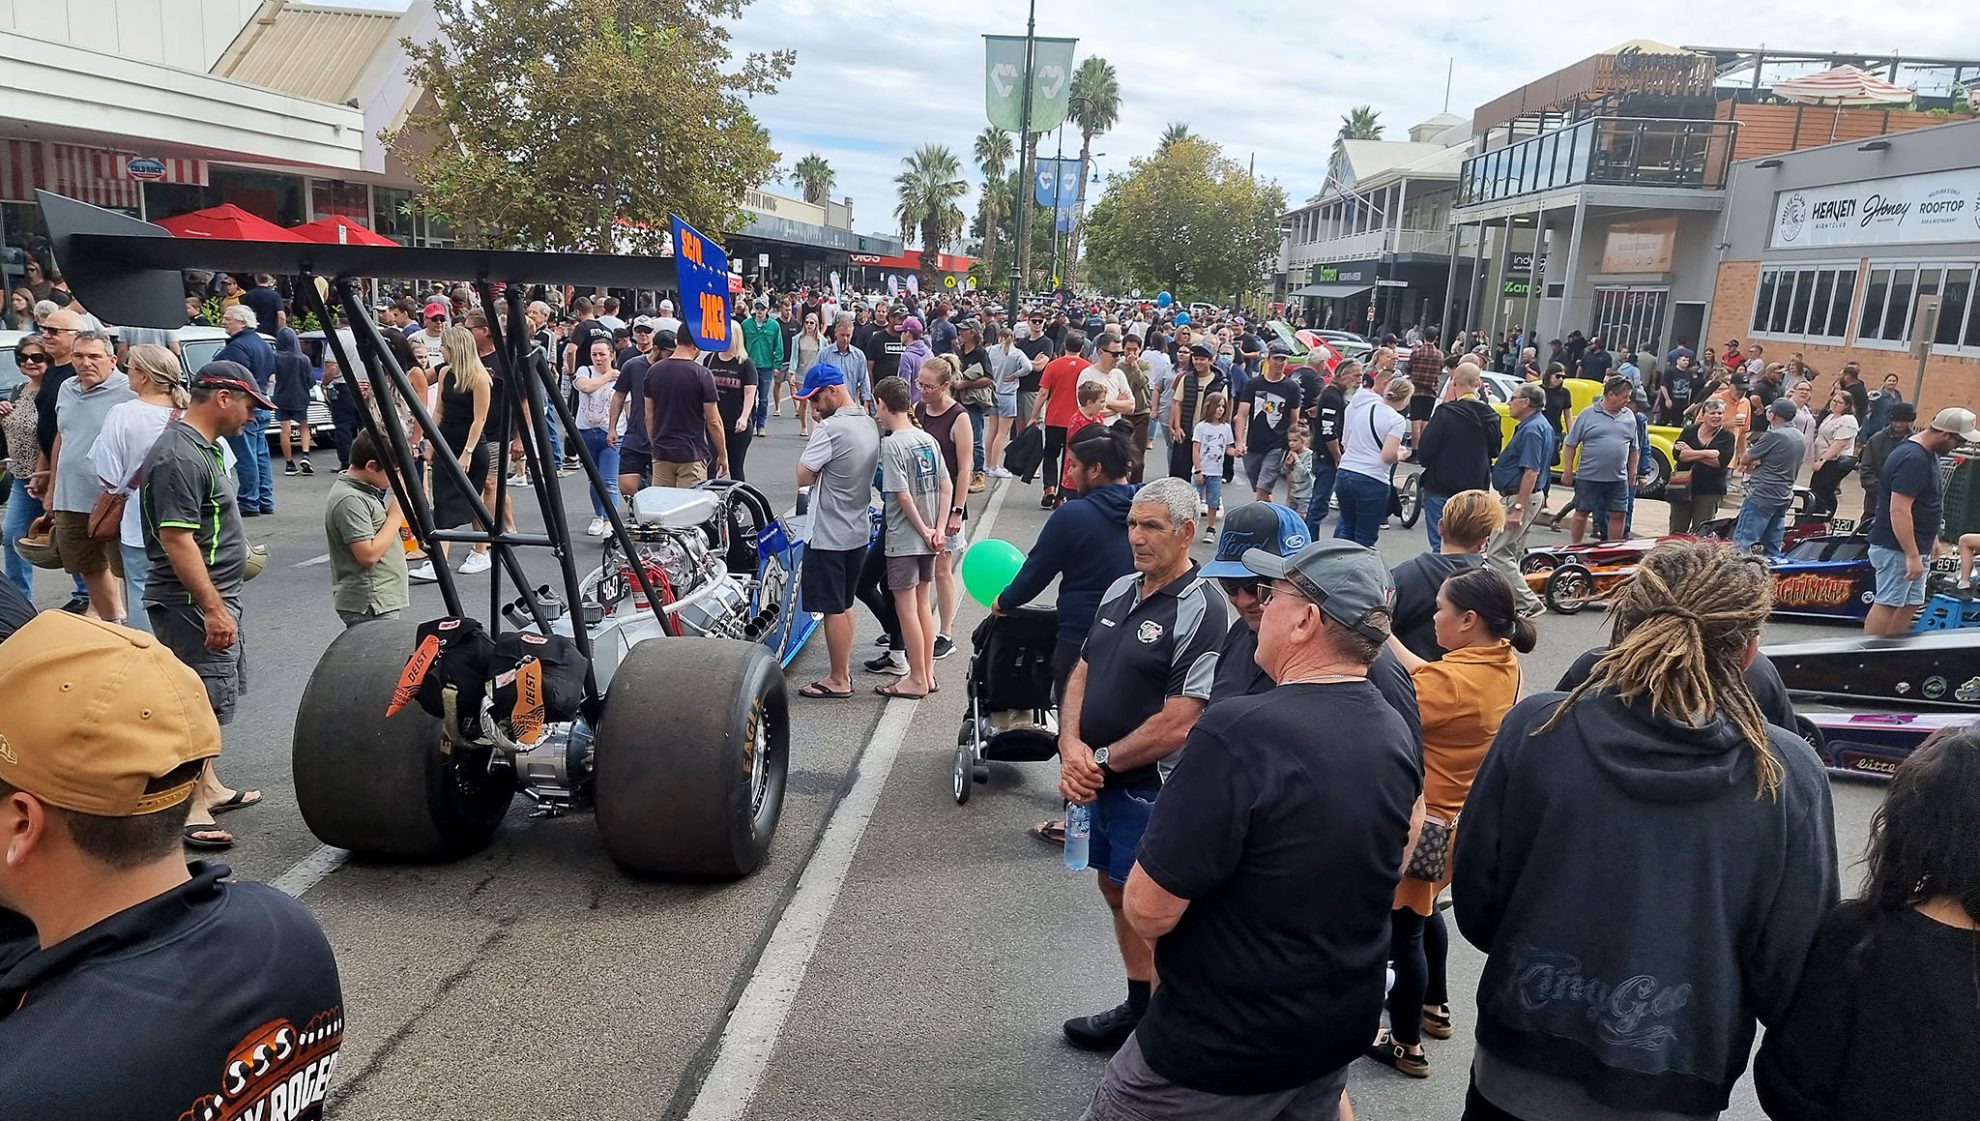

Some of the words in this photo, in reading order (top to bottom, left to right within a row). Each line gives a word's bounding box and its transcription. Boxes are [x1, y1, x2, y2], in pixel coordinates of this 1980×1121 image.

[1811, 199, 1856, 221] HEAVEN
[1860, 194, 1911, 227] Honey
[1919, 200, 1964, 214] ROOFTOP
[407, 650, 428, 683] DEIST
[525, 671, 536, 706] DEIST
[742, 694, 761, 773] EAGLE
